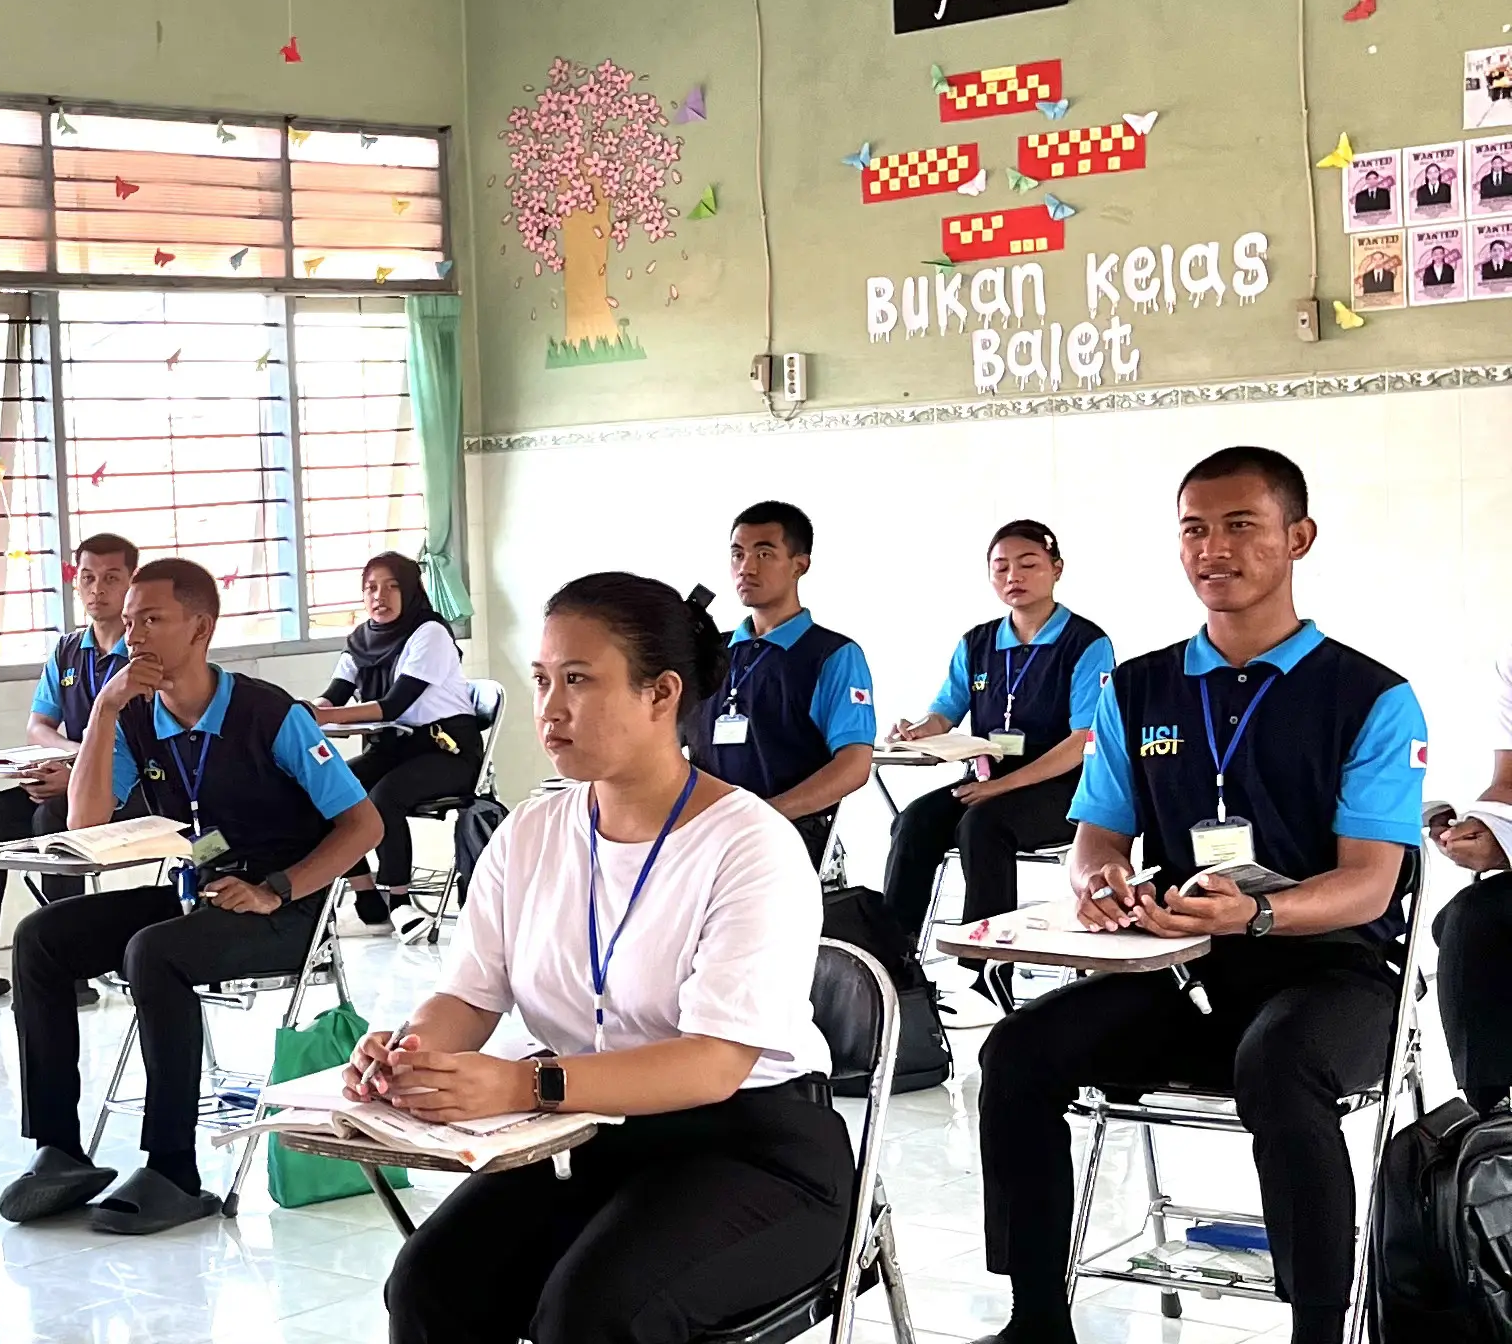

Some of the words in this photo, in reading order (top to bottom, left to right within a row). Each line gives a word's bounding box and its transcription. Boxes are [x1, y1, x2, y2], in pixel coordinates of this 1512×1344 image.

[1412, 149, 1455, 162] WANTED
[1352, 157, 1393, 169] WANTED
[1417, 229, 1459, 242] WANTED
[1477, 223, 1512, 235] WANTE
[1357, 235, 1399, 247] WANTED
[971, 315, 1141, 395] Balet
[1140, 725, 1185, 757] HSI
